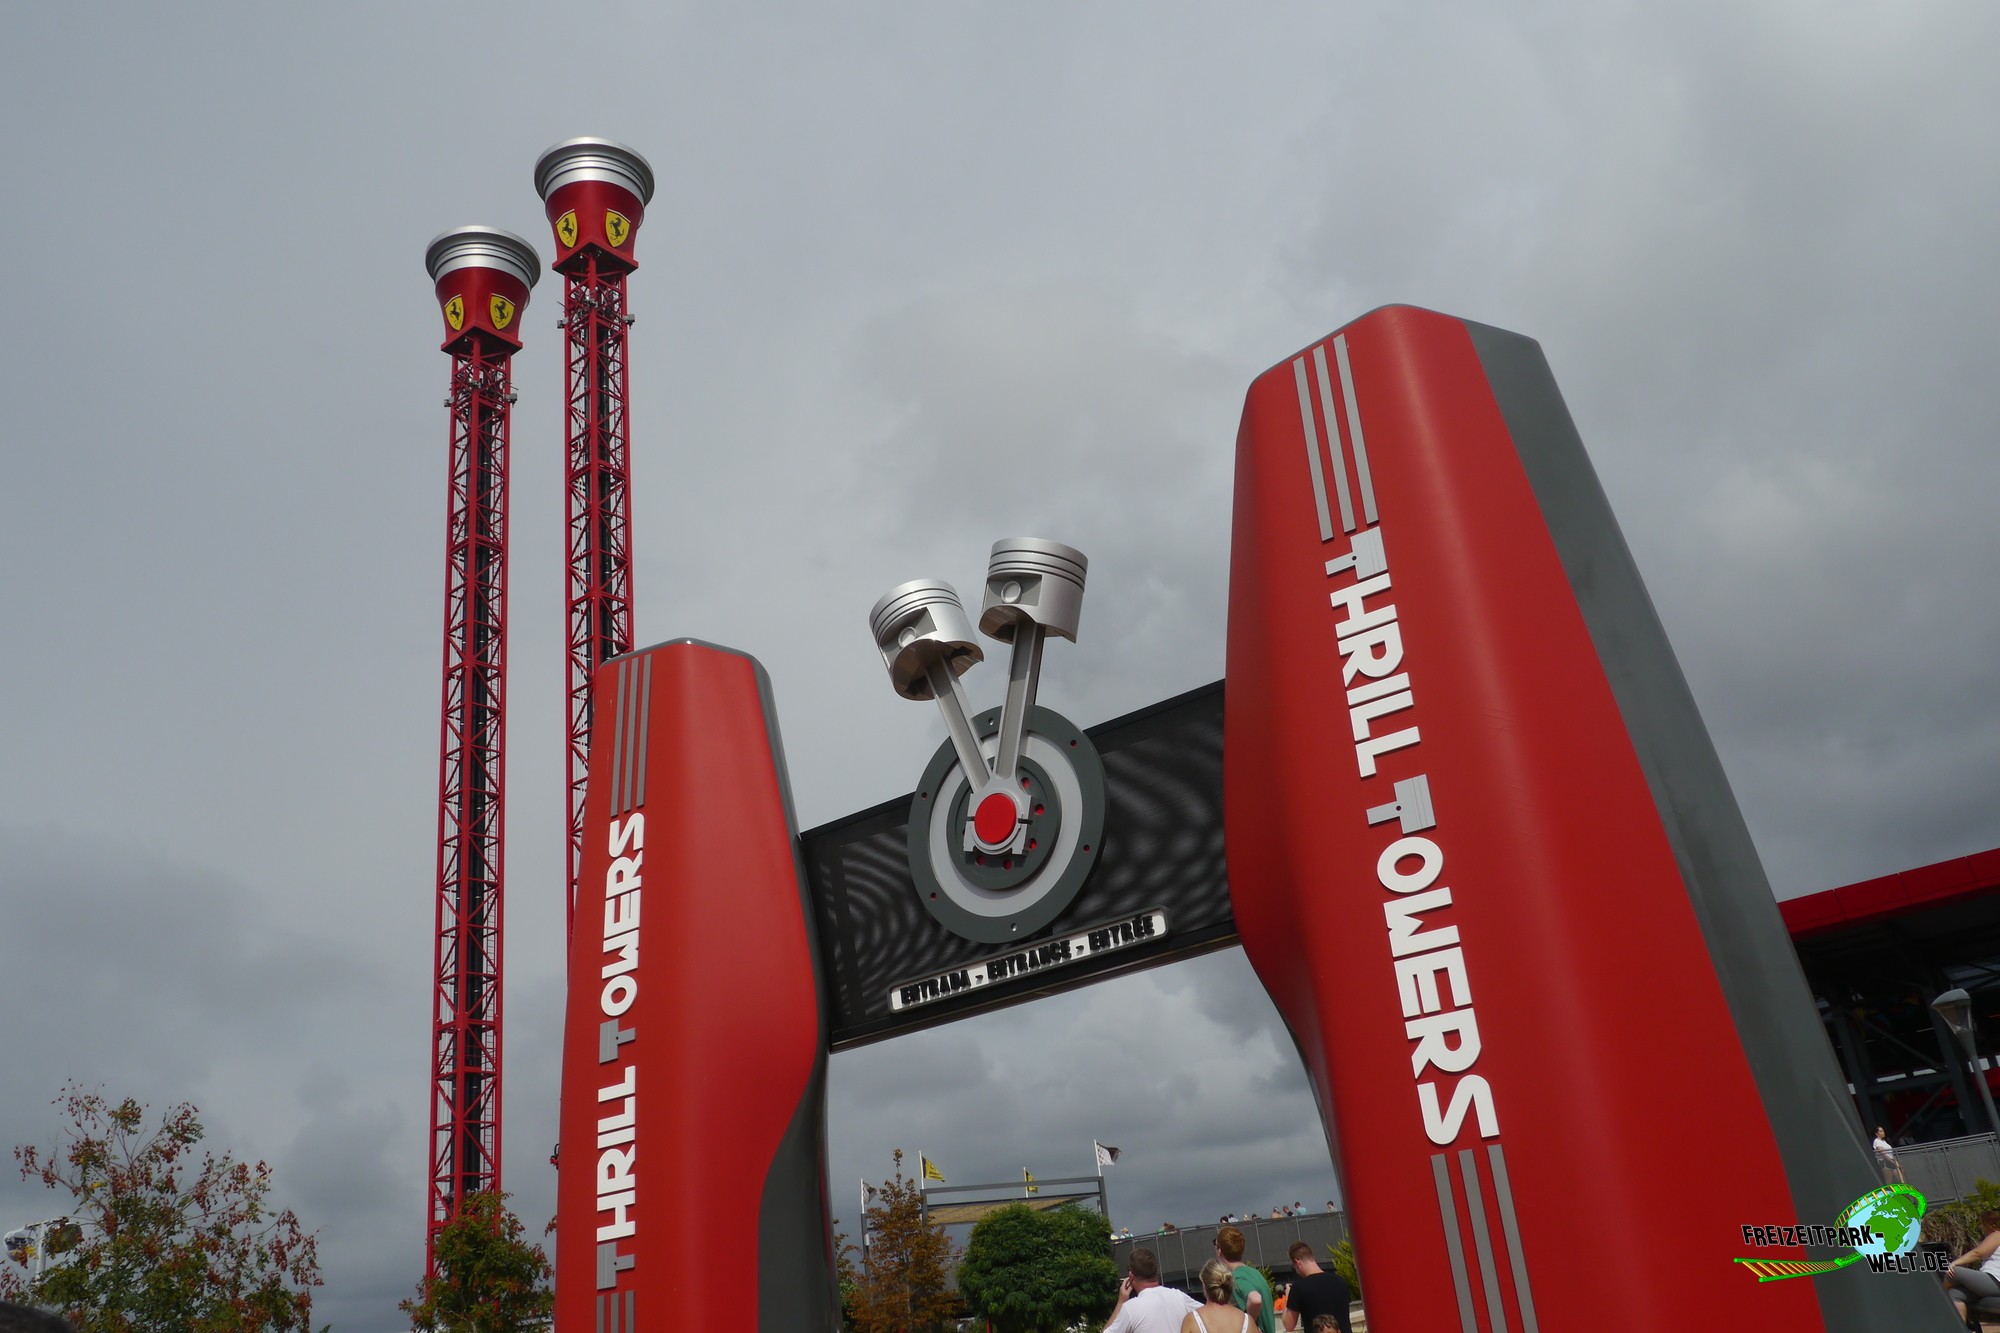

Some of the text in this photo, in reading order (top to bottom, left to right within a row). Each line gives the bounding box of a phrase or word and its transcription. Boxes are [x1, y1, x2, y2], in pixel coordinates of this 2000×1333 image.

[596, 811, 646, 1290] THRILL TOWERS
[900, 969, 971, 1005] ENTRADA
[986, 940, 1072, 980] ENTRANCE
[1088, 914, 1155, 951] ENTRÉE
[1324, 525, 1501, 1146] THRILL TOWERS
